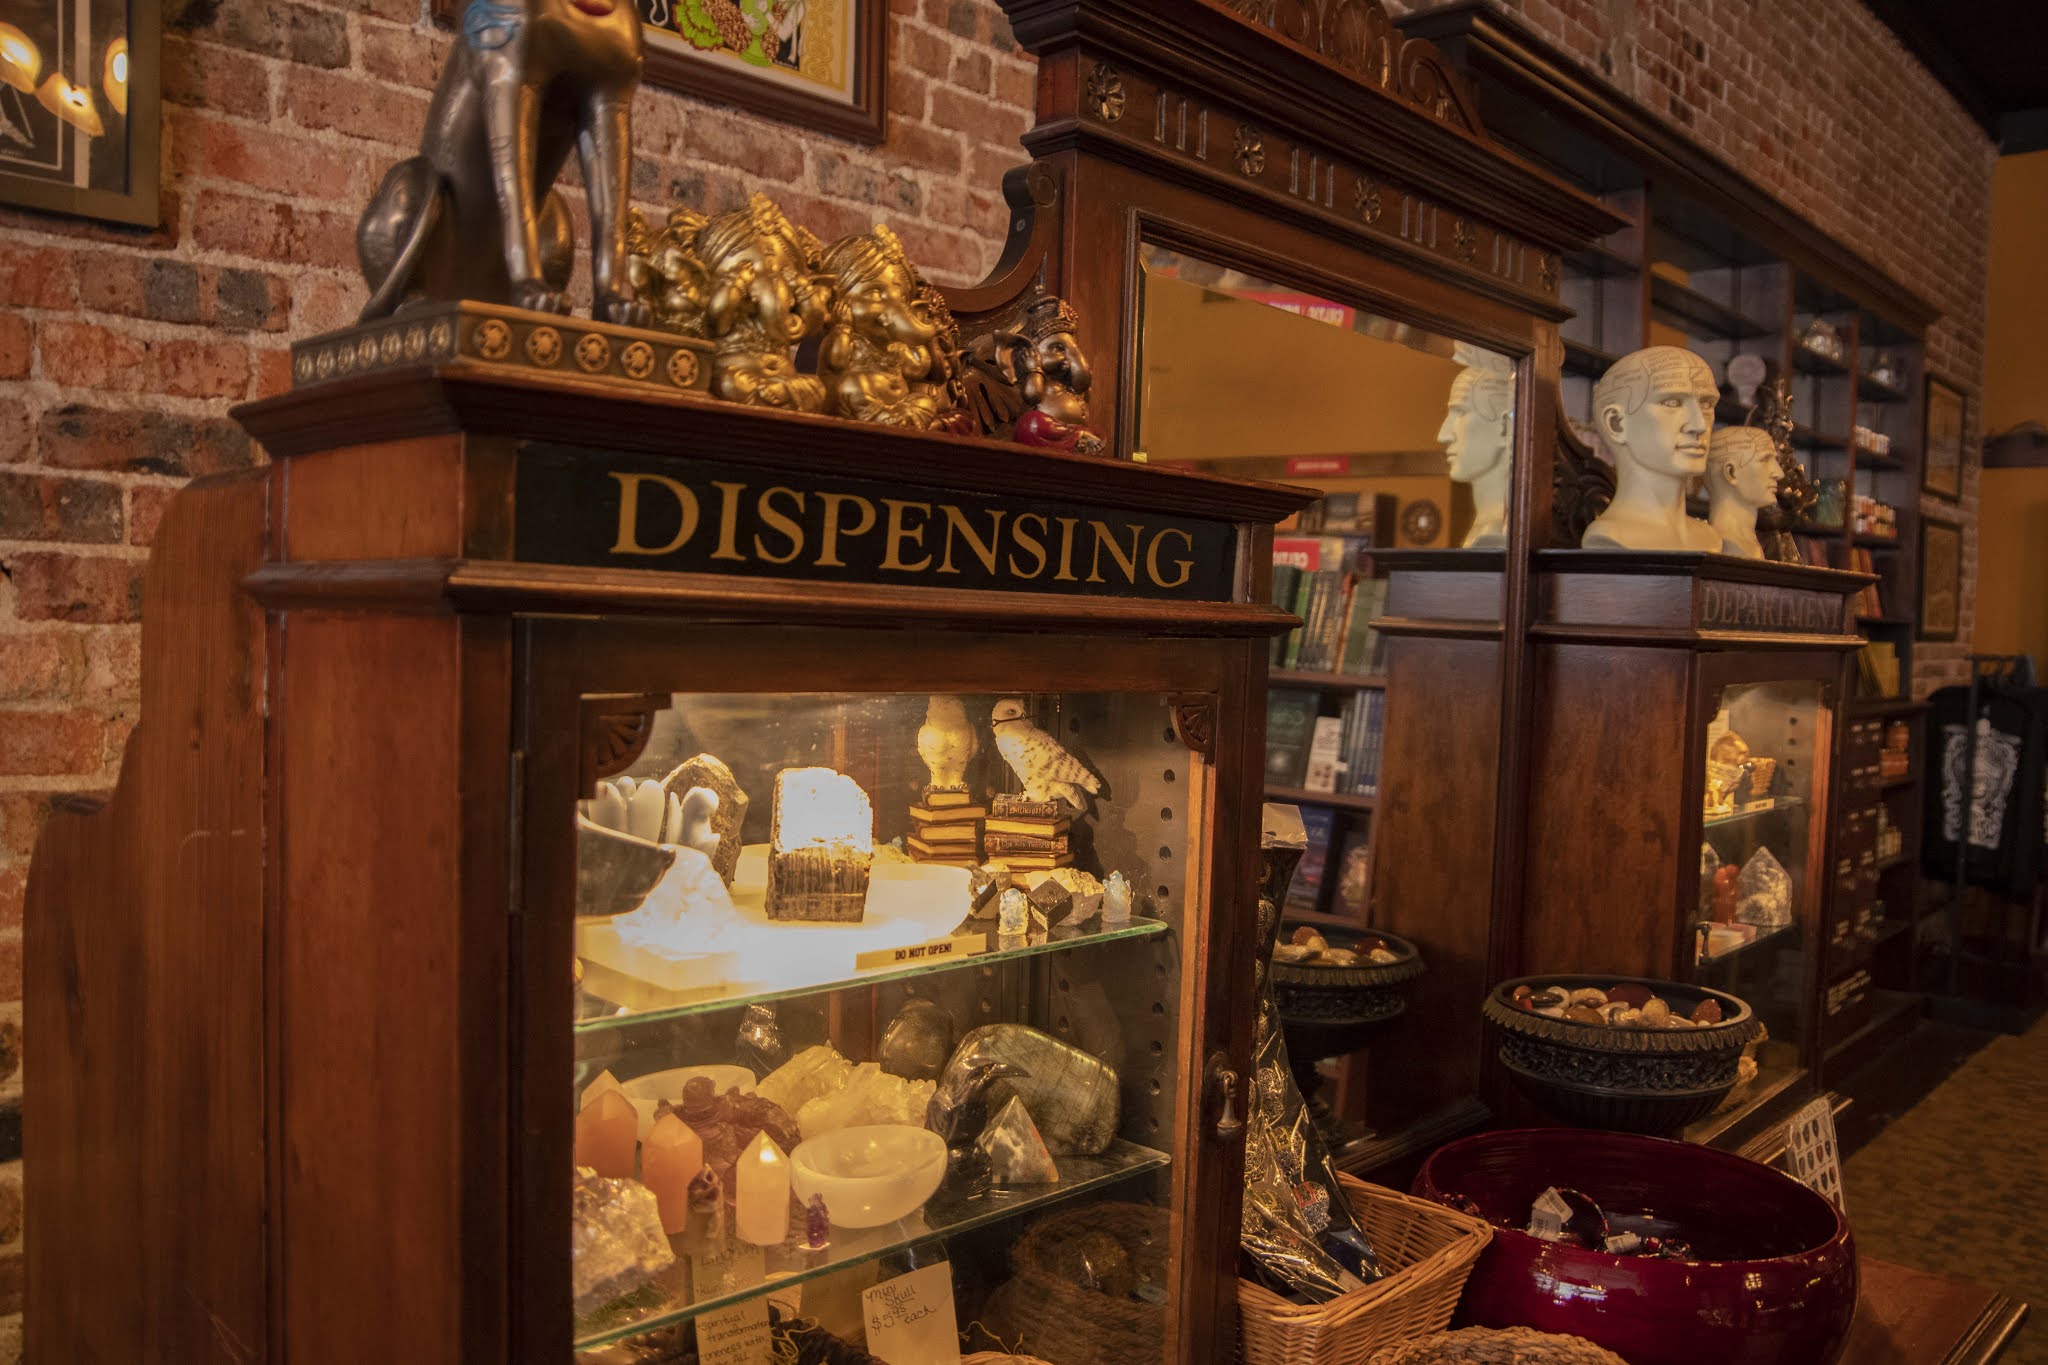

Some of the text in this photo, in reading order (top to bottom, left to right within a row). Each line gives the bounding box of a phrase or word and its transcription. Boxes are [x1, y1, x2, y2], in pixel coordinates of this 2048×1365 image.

[607, 471, 1194, 588] DISPENSING
[1702, 586, 1840, 629] DEPARTMENT
[895, 942, 952, 960] DO NOT OPEN!
[904, 1304, 937, 1324] each
